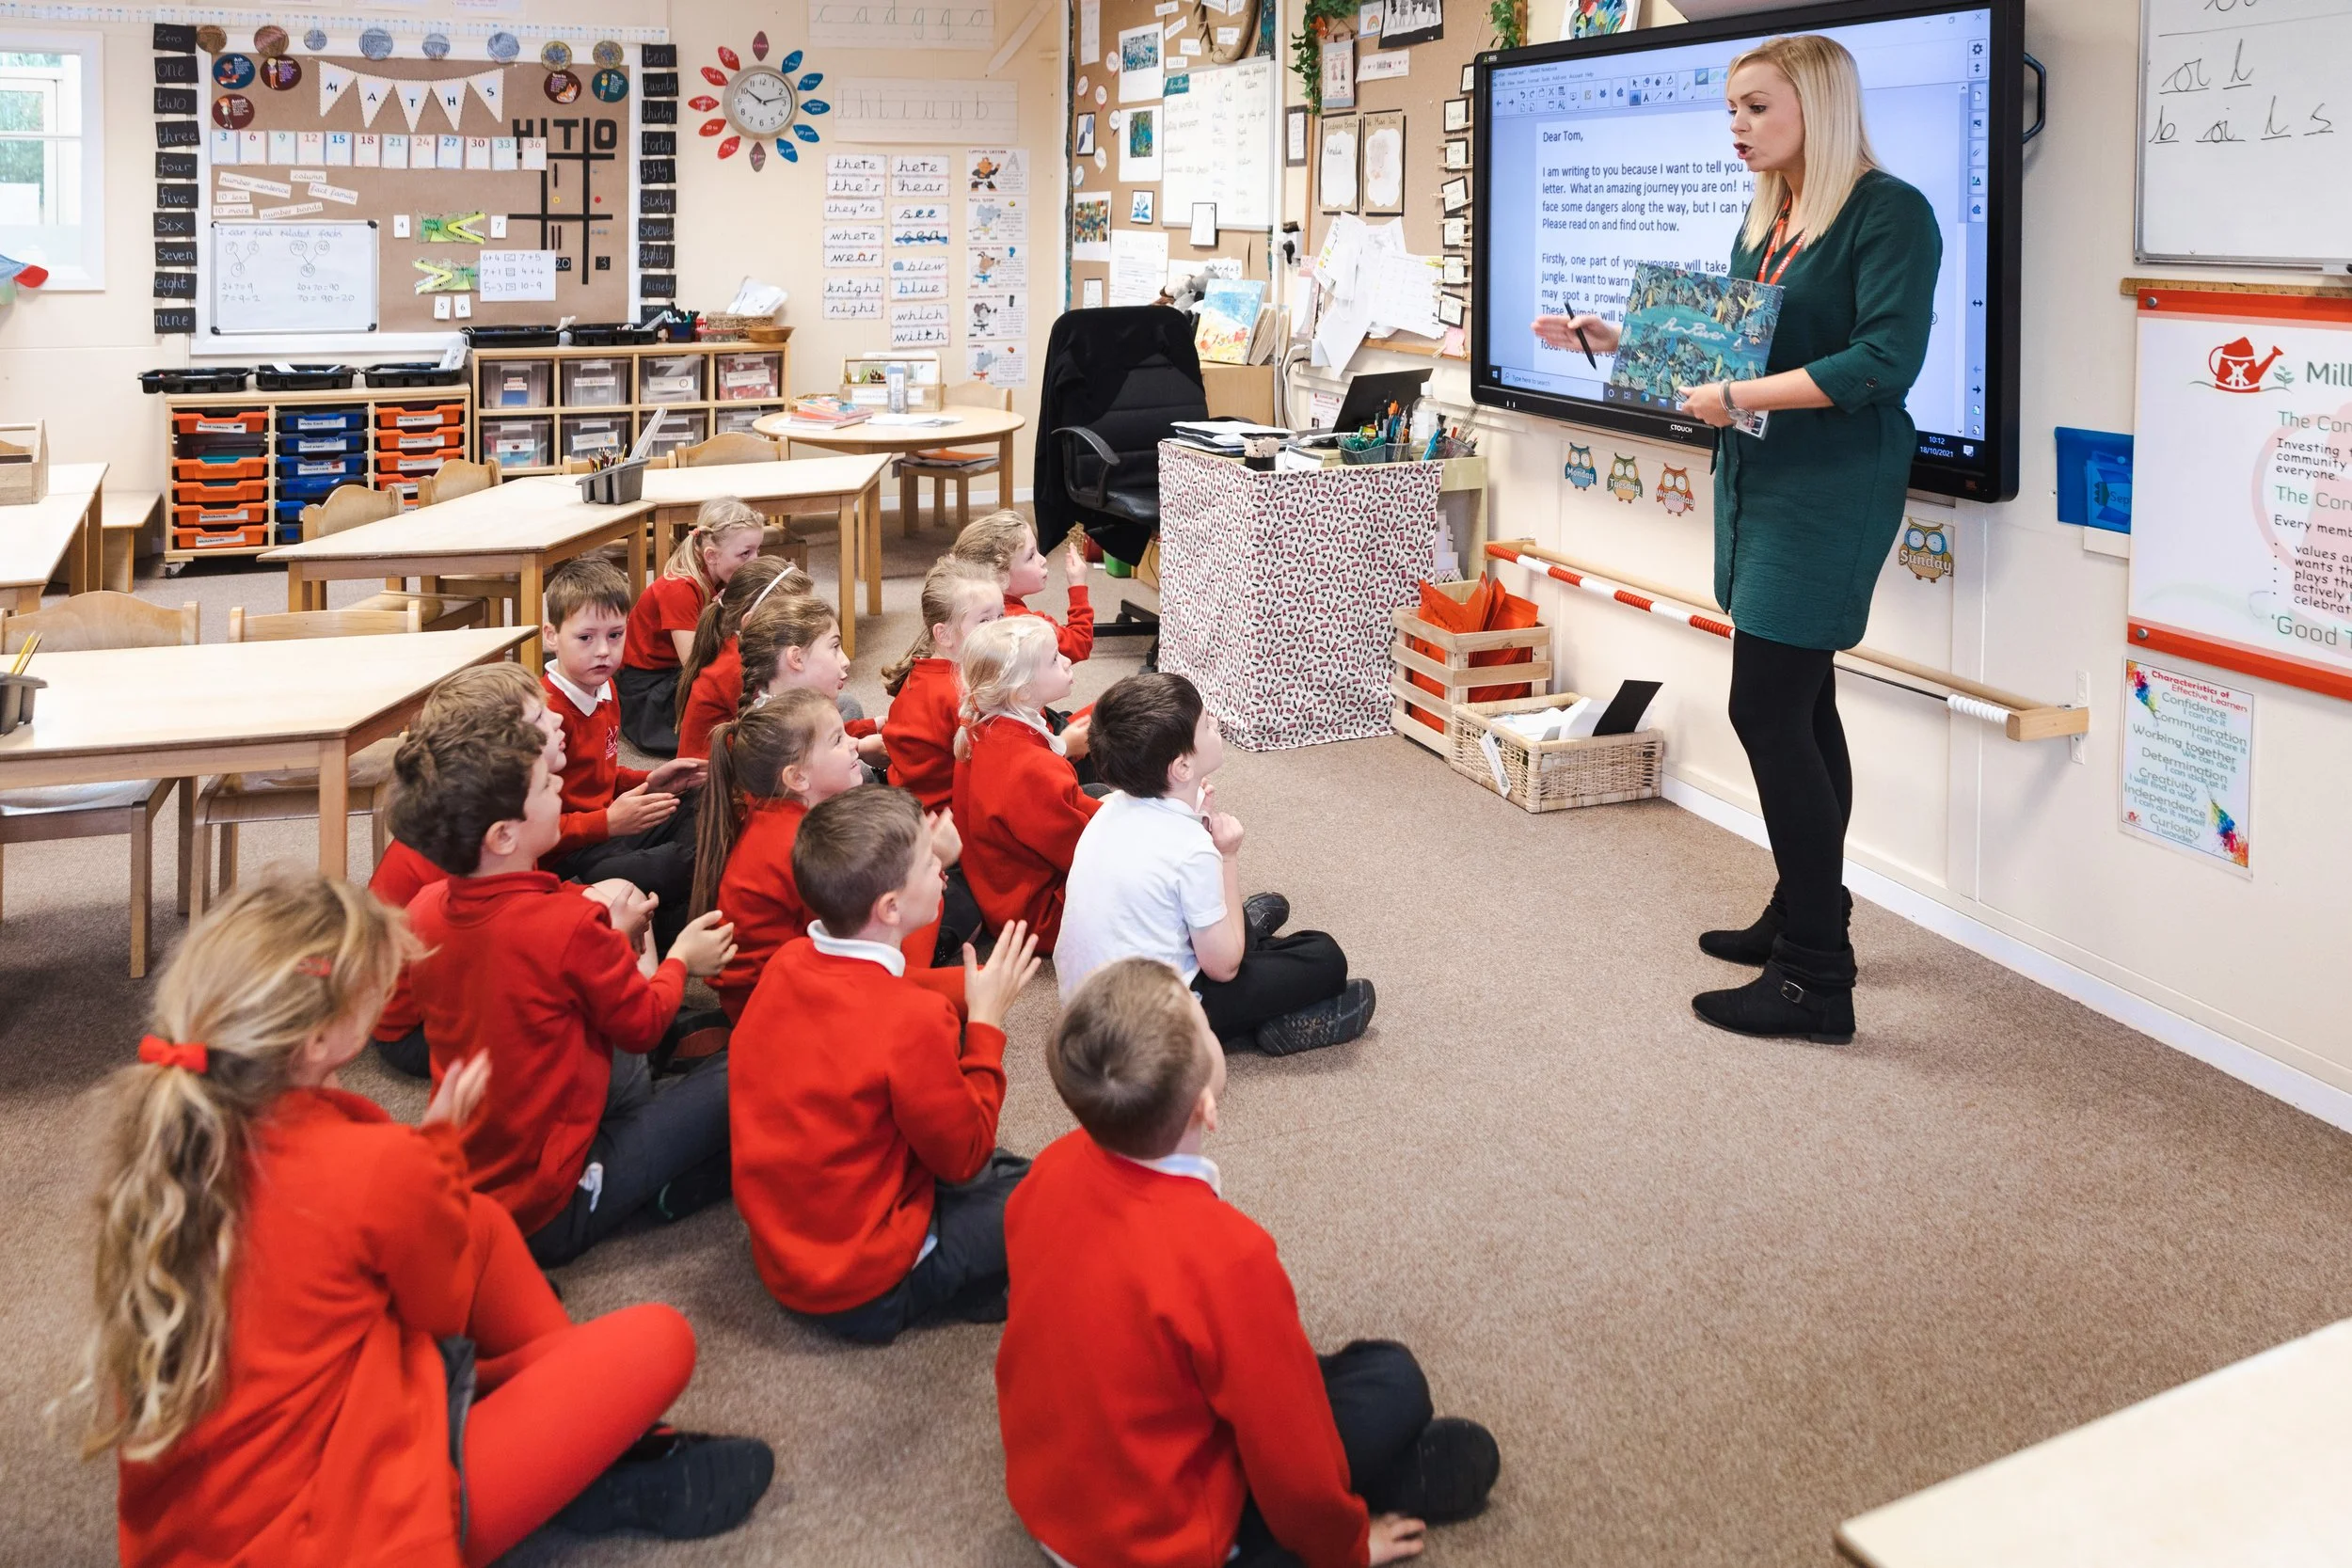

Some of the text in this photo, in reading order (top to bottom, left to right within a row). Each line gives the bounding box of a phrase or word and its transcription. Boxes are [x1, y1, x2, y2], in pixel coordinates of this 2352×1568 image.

[645, 47, 669, 64] ten
[644, 77, 675, 92] twenty
[157, 97, 187, 110] two
[644, 101, 672, 123] thirty
[159, 127, 197, 144] three
[332, 135, 345, 144] 15
[361, 135, 373, 144] 18
[389, 138, 402, 147] 21
[417, 138, 429, 147] 24
[444, 138, 457, 147] 27
[471, 139, 485, 148] 30
[498, 140, 511, 149] 33
[528, 140, 541, 149] 36
[553, 119, 579, 150] T
[1543, 131, 1583, 142] Dear Tom,
[644, 134, 670, 154] forty
[158, 157, 192, 177] four
[642, 160, 668, 181] fifty
[1547, 168, 1559, 177] am
[1562, 166, 1590, 179] writing
[1593, 166, 1600, 176] to
[1603, 167, 1618, 178] you
[1622, 164, 1657, 175] because
[1666, 164, 1690, 174] want
[1692, 163, 1702, 172] to
[1706, 161, 1721, 172] tell
[1724, 164, 1743, 175] you
[898, 180, 944, 191] hear
[1543, 183, 1565, 194] letter.
[1570, 183, 1592, 194] What
[1606, 182, 1642, 196] amazing
[1644, 182, 1678, 196] journey
[1681, 183, 1698, 195] you
[1702, 183, 1717, 192] are
[1720, 181, 1737, 192] on!
[159, 186, 188, 207] five
[899, 210, 936, 218] see
[1543, 201, 1559, 212] face
[1561, 203, 1582, 212] some
[1585, 201, 1618, 214] dangers
[1622, 201, 1645, 215] along
[1648, 201, 1663, 213] the
[1667, 203, 1689, 215] way,
[1693, 201, 1709, 213] but
[1720, 203, 1737, 214] can
[1543, 218, 1566, 229] Please
[1569, 218, 1587, 230] read
[1601, 219, 1617, 230] and
[1620, 219, 1636, 230] find
[1639, 220, 1654, 230] out
[1657, 220, 1678, 231] how.
[640, 245, 669, 267] eighty
[831, 252, 877, 261] wear
[1542, 253, 1567, 266] Firstly,
[1590, 256, 1607, 268] part
[1611, 255, 1619, 266] of
[1685, 261, 1700, 271] will
[1705, 261, 1726, 272] take
[906, 261, 945, 271] blew
[154, 273, 187, 296] eight
[646, 278, 674, 296] ninety
[898, 282, 940, 293] blue
[1542, 272, 1567, 283] jungle.
[1576, 275, 1596, 284] want
[1597, 276, 1606, 284] to
[1608, 277, 1629, 286] warn
[828, 280, 880, 296] knight
[1542, 291, 1558, 300] may
[1563, 291, 1580, 303] spot
[830, 303, 876, 316] night
[896, 306, 945, 321] which
[1542, 305, 1615, 322] These will
[155, 314, 188, 326] nine
[895, 329, 947, 341] witch
[2278, 411, 2310, 428] The
[1671, 424, 1692, 433] CTOUCH
[1929, 436, 1945, 445] 10:12
[2277, 438, 2339, 458] Investing
[1920, 446, 1953, 457] 18/10/2021
[2277, 452, 2346, 471] community
[1566, 467, 1594, 484] Monday
[2276, 465, 2340, 482] everyone.
[1610, 479, 1640, 496] Tuesday
[2275, 485, 2308, 504] The
[1656, 489, 1693, 507] Wednesday
[2275, 515, 2311, 531] Every
[2296, 545, 2336, 560] values
[1900, 549, 1951, 575] Sunday
[2295, 558, 2332, 572] wants
[2295, 570, 2328, 586] plays
[2294, 583, 2344, 601] actively
[2152, 671, 2217, 695] Characteristics
[2171, 685, 2208, 701] Effective
[2162, 692, 2226, 720] Confidence
[2153, 710, 2247, 746] Communication
[2133, 723, 2236, 764] Working together
[2142, 747, 2227, 784] Determination
[2139, 768, 2197, 795] Creativity
[2124, 783, 2205, 817] Independence
[2150, 814, 2200, 839] Curiosity
